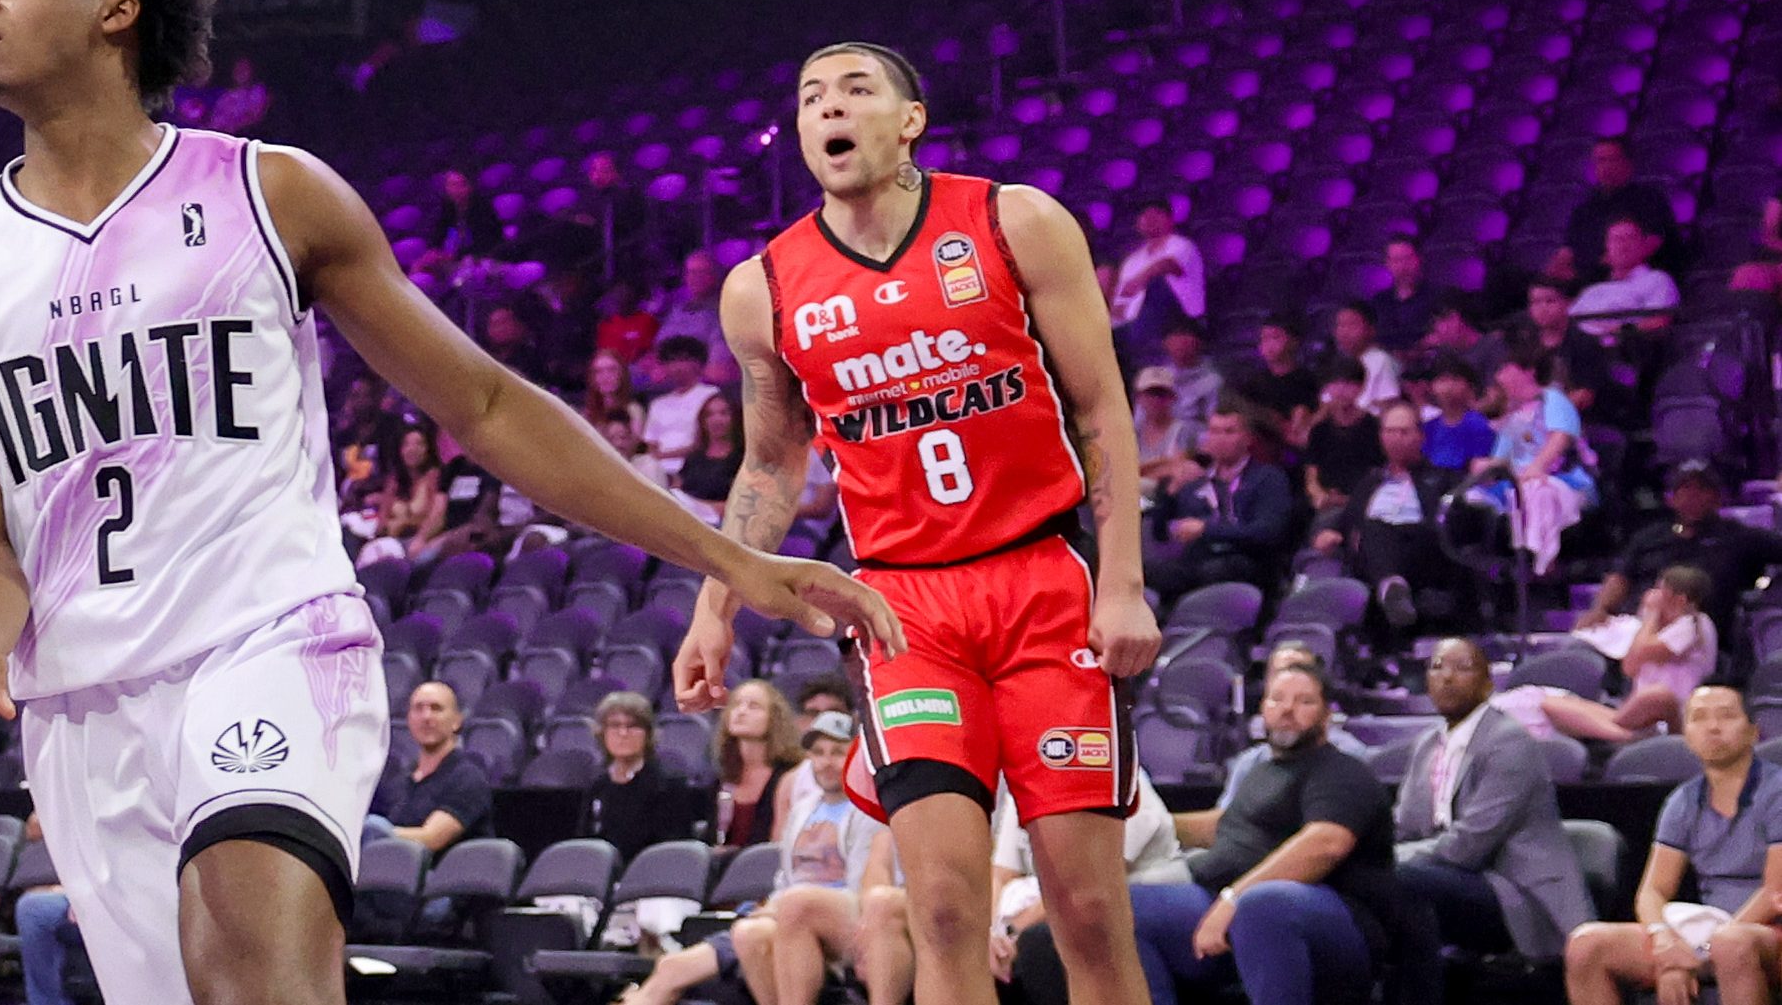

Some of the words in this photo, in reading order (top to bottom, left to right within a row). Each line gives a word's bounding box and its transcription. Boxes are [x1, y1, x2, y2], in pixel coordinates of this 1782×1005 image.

[49, 282, 142, 319] NBAGL
[826, 325, 861, 343] bank
[831, 328, 987, 392] mate.
[830, 363, 1027, 445] WILDCATS
[921, 362, 981, 391] mobile
[916, 427, 975, 506] 8
[94, 462, 137, 586] 2
